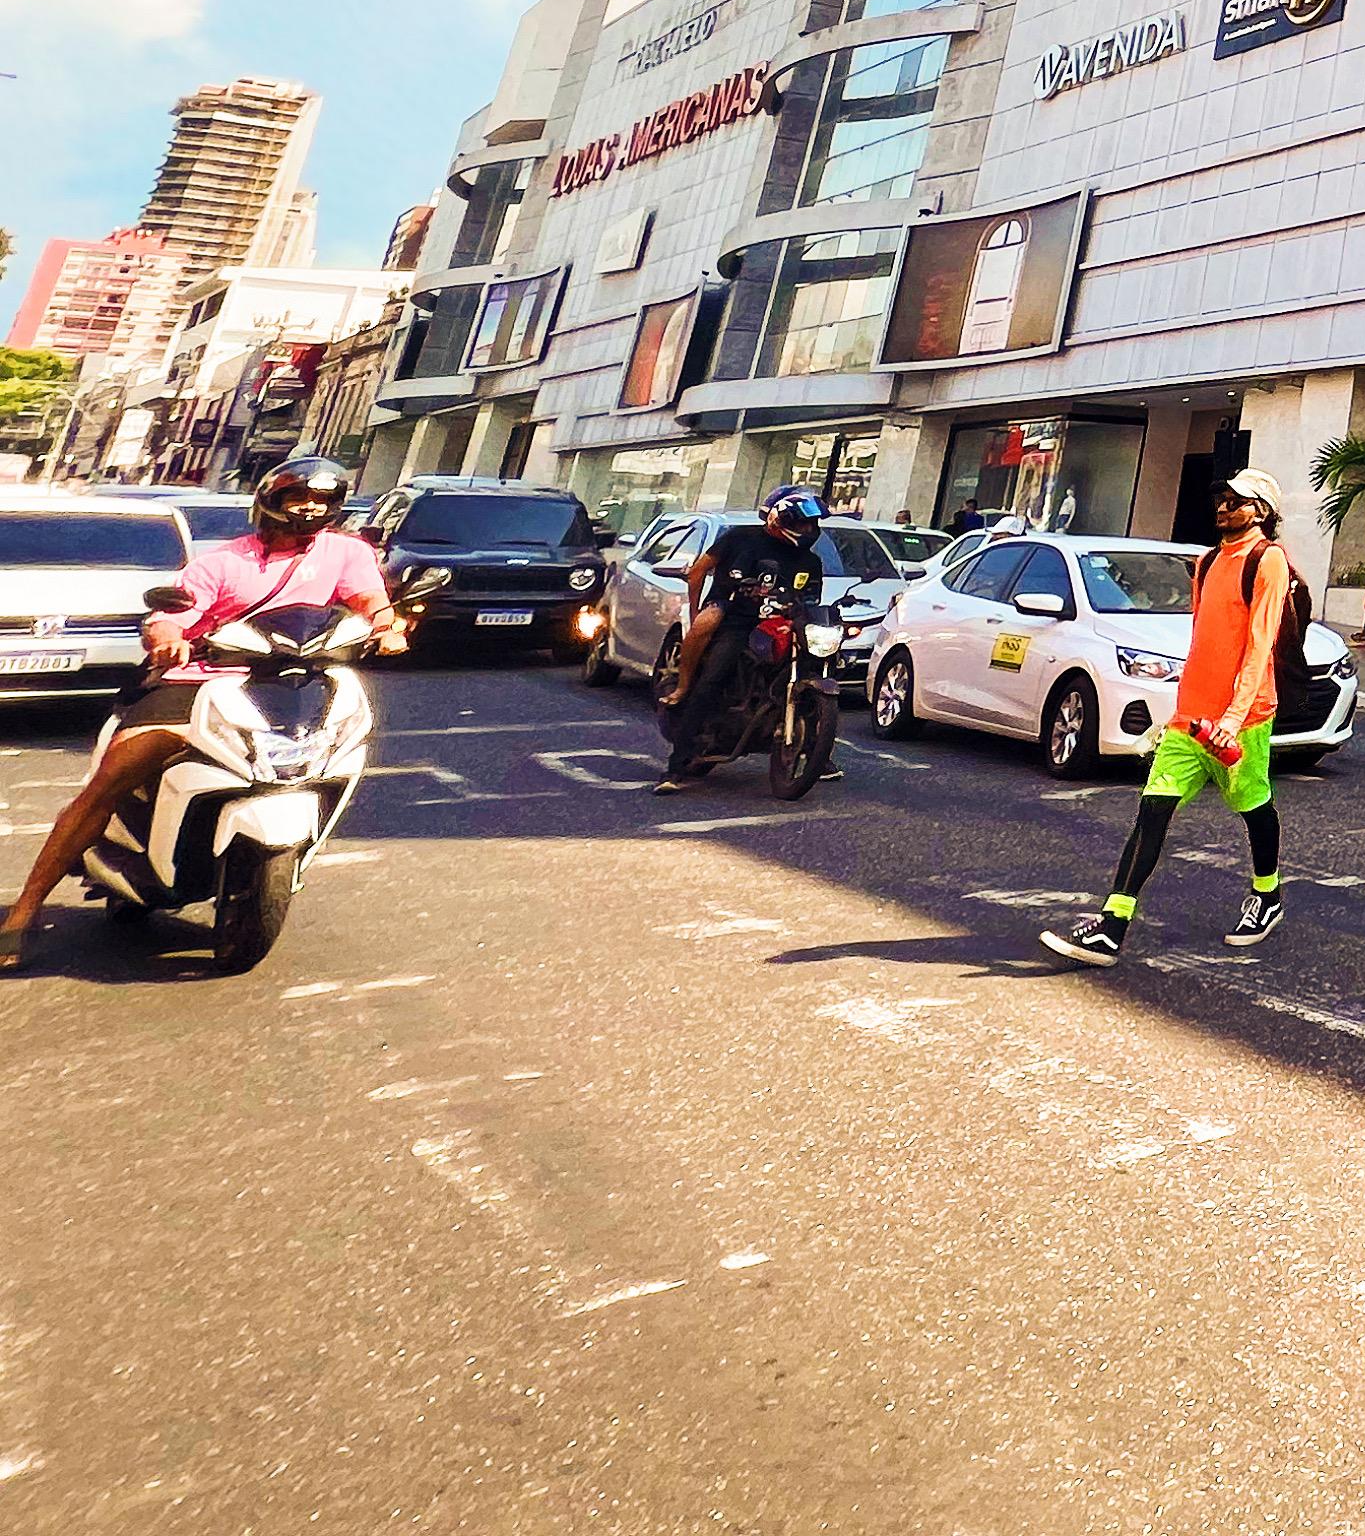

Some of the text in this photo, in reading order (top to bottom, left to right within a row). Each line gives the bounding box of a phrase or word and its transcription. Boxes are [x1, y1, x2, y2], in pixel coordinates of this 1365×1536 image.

[1056, 9, 1186, 91] AVENIDA
[548, 61, 770, 199] LOJAS AMERICANAS
